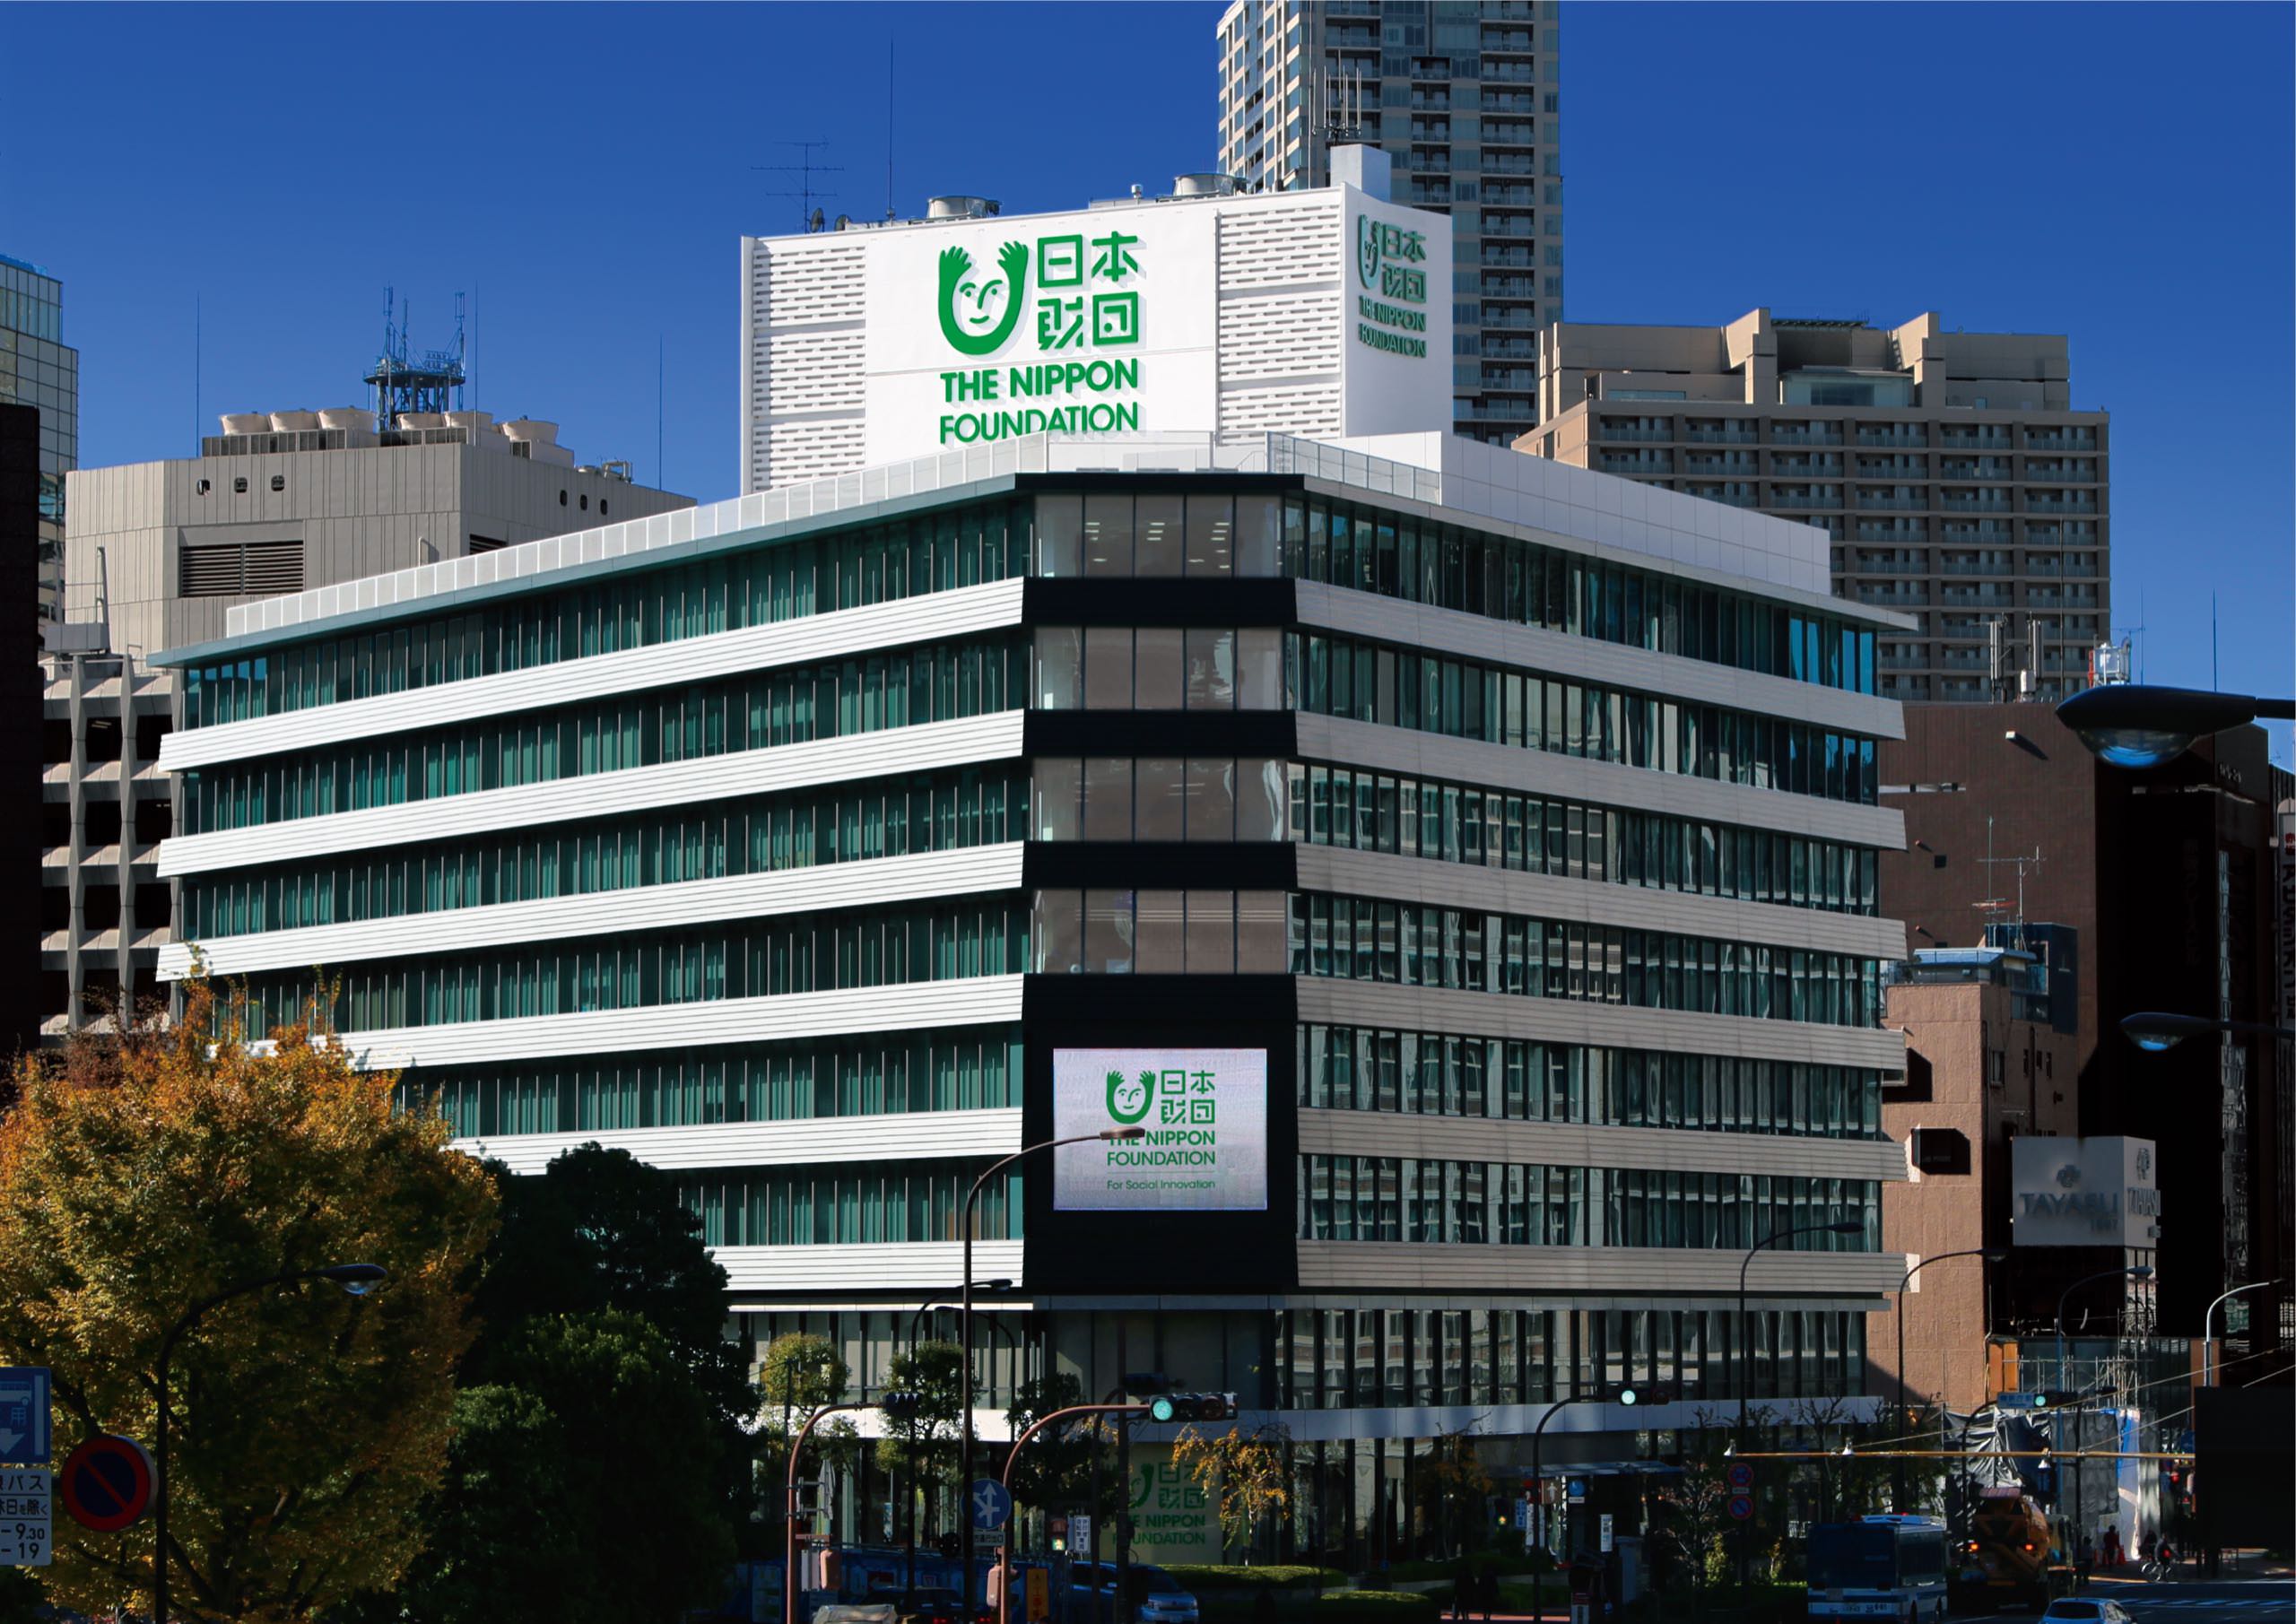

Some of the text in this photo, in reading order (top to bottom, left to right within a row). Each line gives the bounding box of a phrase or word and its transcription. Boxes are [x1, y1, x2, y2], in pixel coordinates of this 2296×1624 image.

[1382, 224, 1426, 263] 日本
[1038, 230, 1138, 288] 日本
[1038, 291, 1138, 350] 財団
[1374, 302, 1426, 332] NIPPON
[1359, 323, 1426, 358] FOUNDATION
[940, 358, 1138, 403] THE NIPPON
[940, 402, 1138, 445] FOUNDATION
[1161, 1070, 1215, 1095] 日本
[1161, 1099, 1215, 1125] 財団
[1145, 1130, 1215, 1146] NIPPON
[1107, 1151, 1215, 1166] FOUNDATION
[1107, 1179, 1215, 1190] For Social Innovation
[0, 1474, 44, 1491] バス
[1146, 1515, 1205, 1527] NIPPON
[1113, 1532, 1205, 1545] UNDATION
